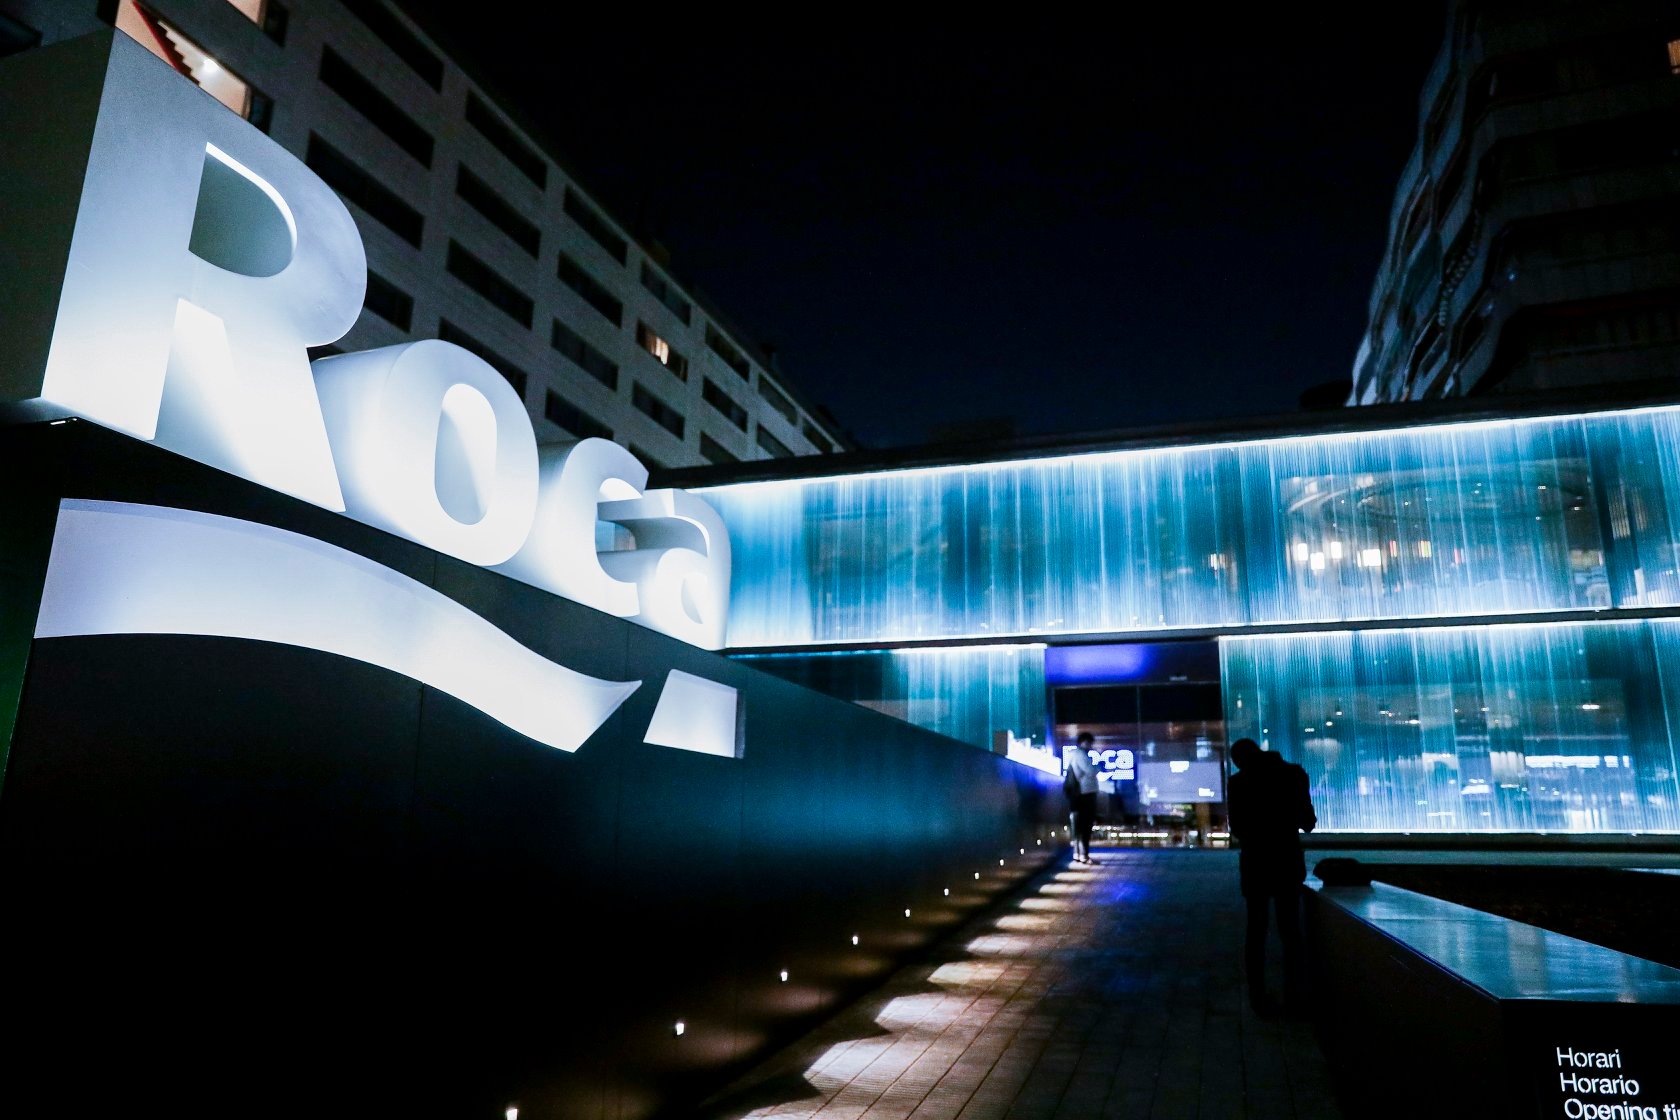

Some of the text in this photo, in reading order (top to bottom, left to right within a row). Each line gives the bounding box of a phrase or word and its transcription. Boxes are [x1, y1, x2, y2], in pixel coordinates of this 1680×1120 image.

[40, 26, 731, 651] Roca
[1556, 1046, 1622, 1069] Horari
[1559, 1072, 1640, 1096] Horario
[1564, 1098, 1680, 1120] Opening ti
